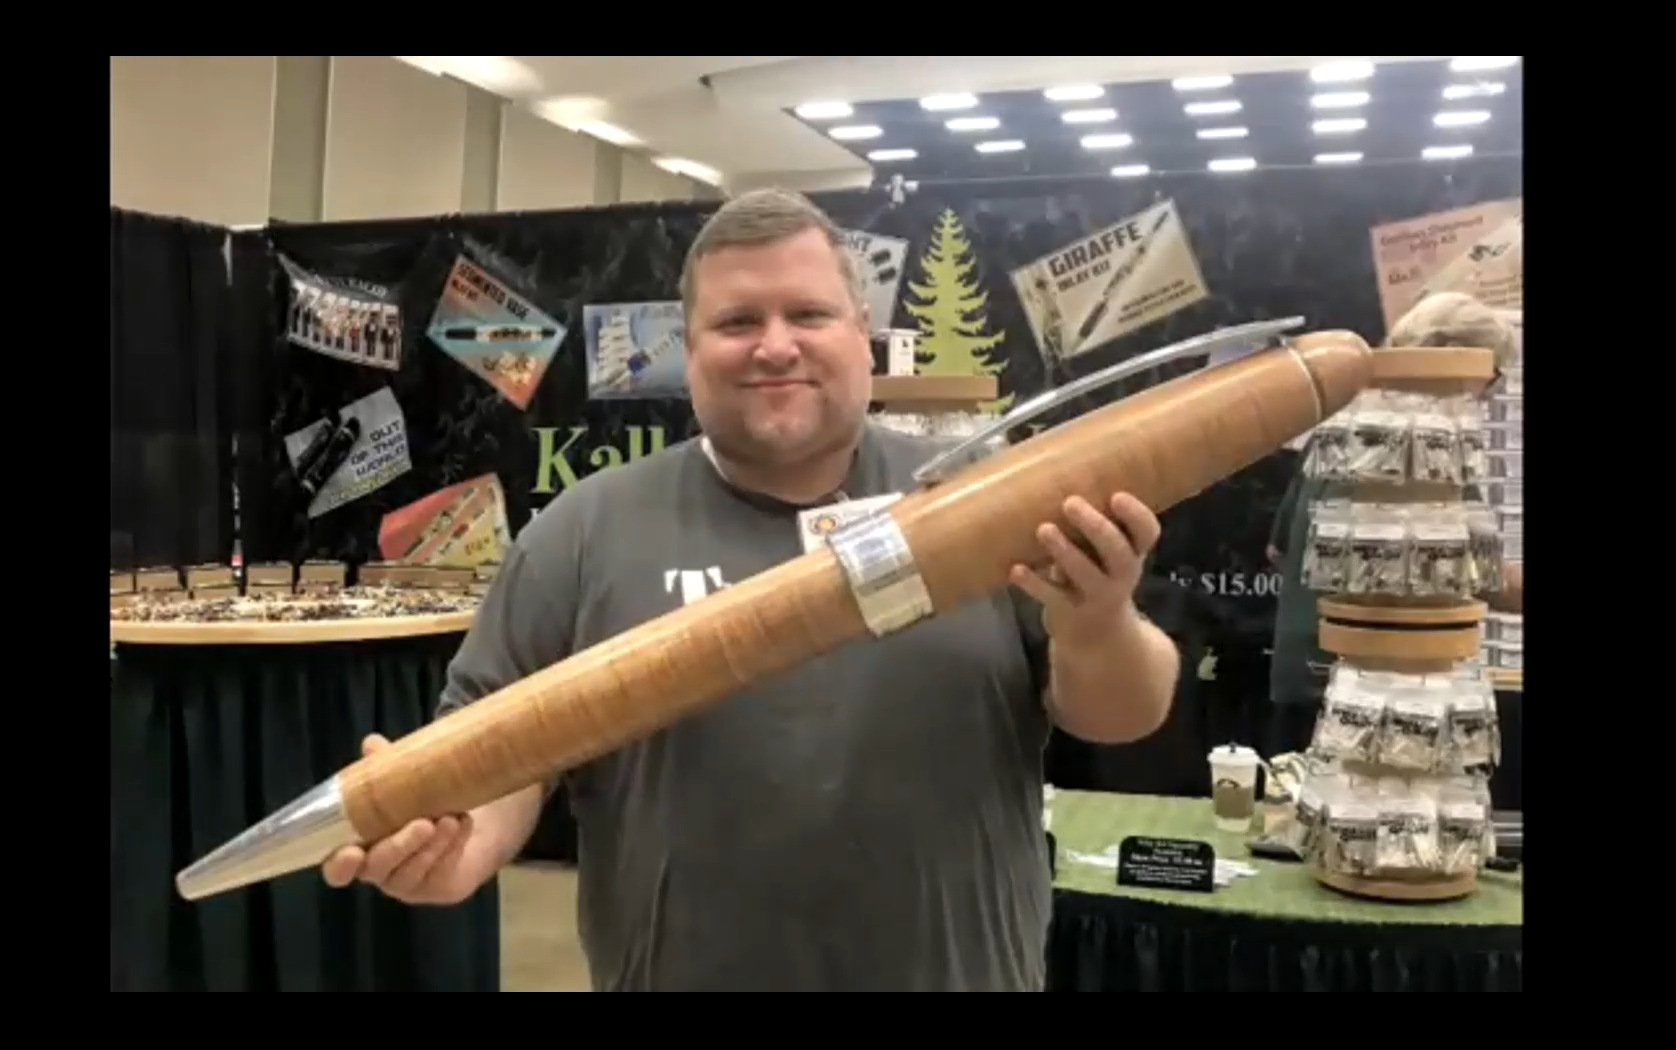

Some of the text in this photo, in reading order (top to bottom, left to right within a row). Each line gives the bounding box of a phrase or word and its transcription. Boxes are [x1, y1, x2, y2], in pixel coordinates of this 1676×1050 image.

[1047, 221, 1143, 278] GIRAFFE
[1057, 259, 1112, 292] INLAY KIT
[368, 419, 400, 442] OUT
[351, 432, 405, 466] OF THIS
[356, 442, 406, 477] WORLD
[1200, 572, 1284, 597] $15.00
